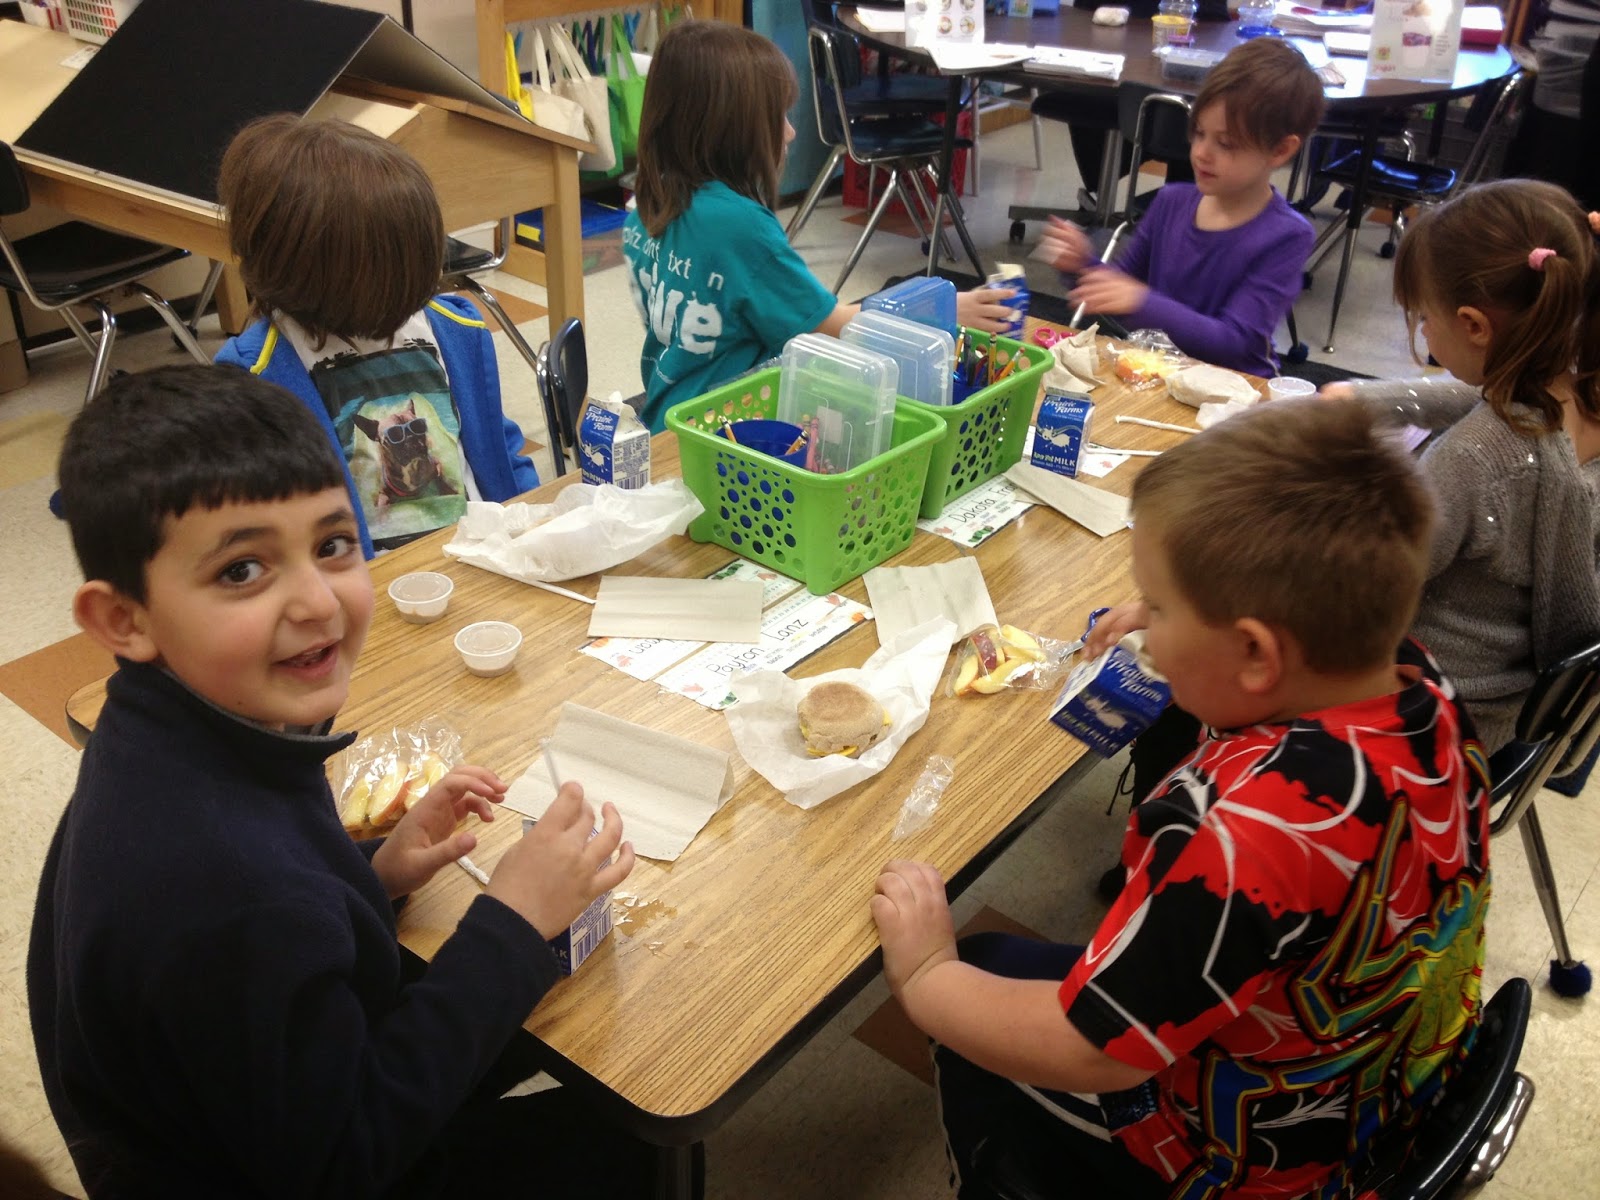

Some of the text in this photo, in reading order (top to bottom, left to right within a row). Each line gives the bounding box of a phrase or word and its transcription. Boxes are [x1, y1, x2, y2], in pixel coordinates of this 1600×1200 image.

[667, 250, 692, 280] txt
[707, 272, 724, 290] n
[1054, 405, 1084, 414] Farms
[1054, 455, 1076, 467] MILK
[948, 497, 996, 523] Dakota
[705, 646, 765, 677] Payton
[760, 618, 809, 641] Lanz
